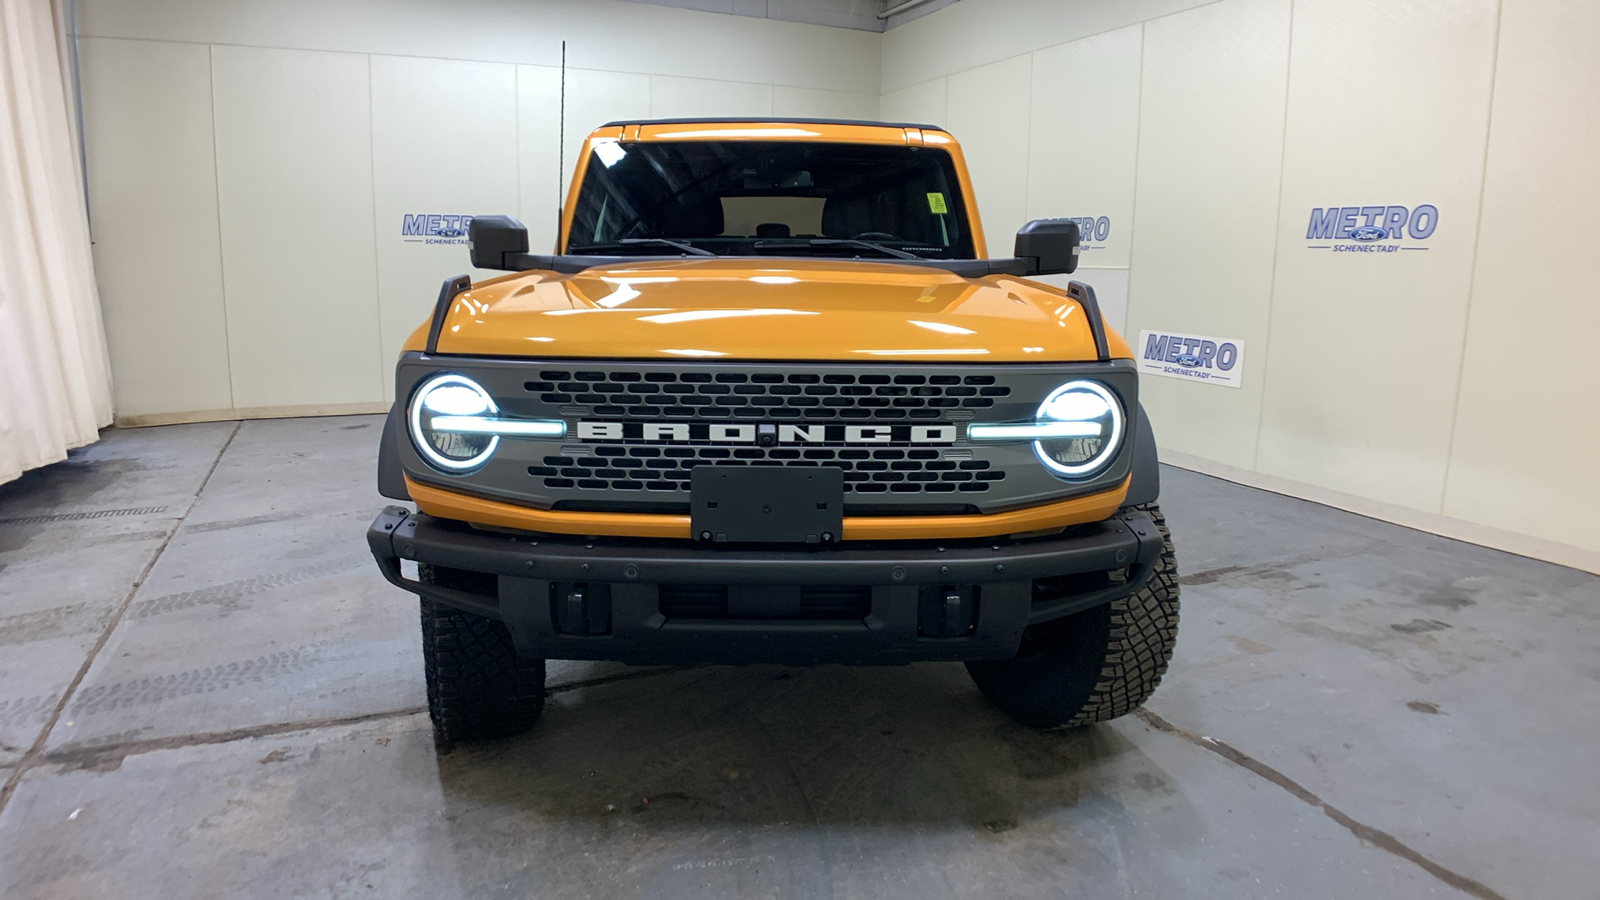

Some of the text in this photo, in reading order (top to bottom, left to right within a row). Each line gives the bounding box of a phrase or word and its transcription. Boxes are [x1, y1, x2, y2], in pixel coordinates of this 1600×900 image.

[402, 214, 474, 236] METR
[1306, 204, 1439, 240] METRO
[1333, 244, 1400, 253] SCHENECTADY
[1144, 333, 1238, 371] METRO
[1163, 366, 1211, 379] SCHENECTADY
[576, 421, 958, 443] BRONCO
